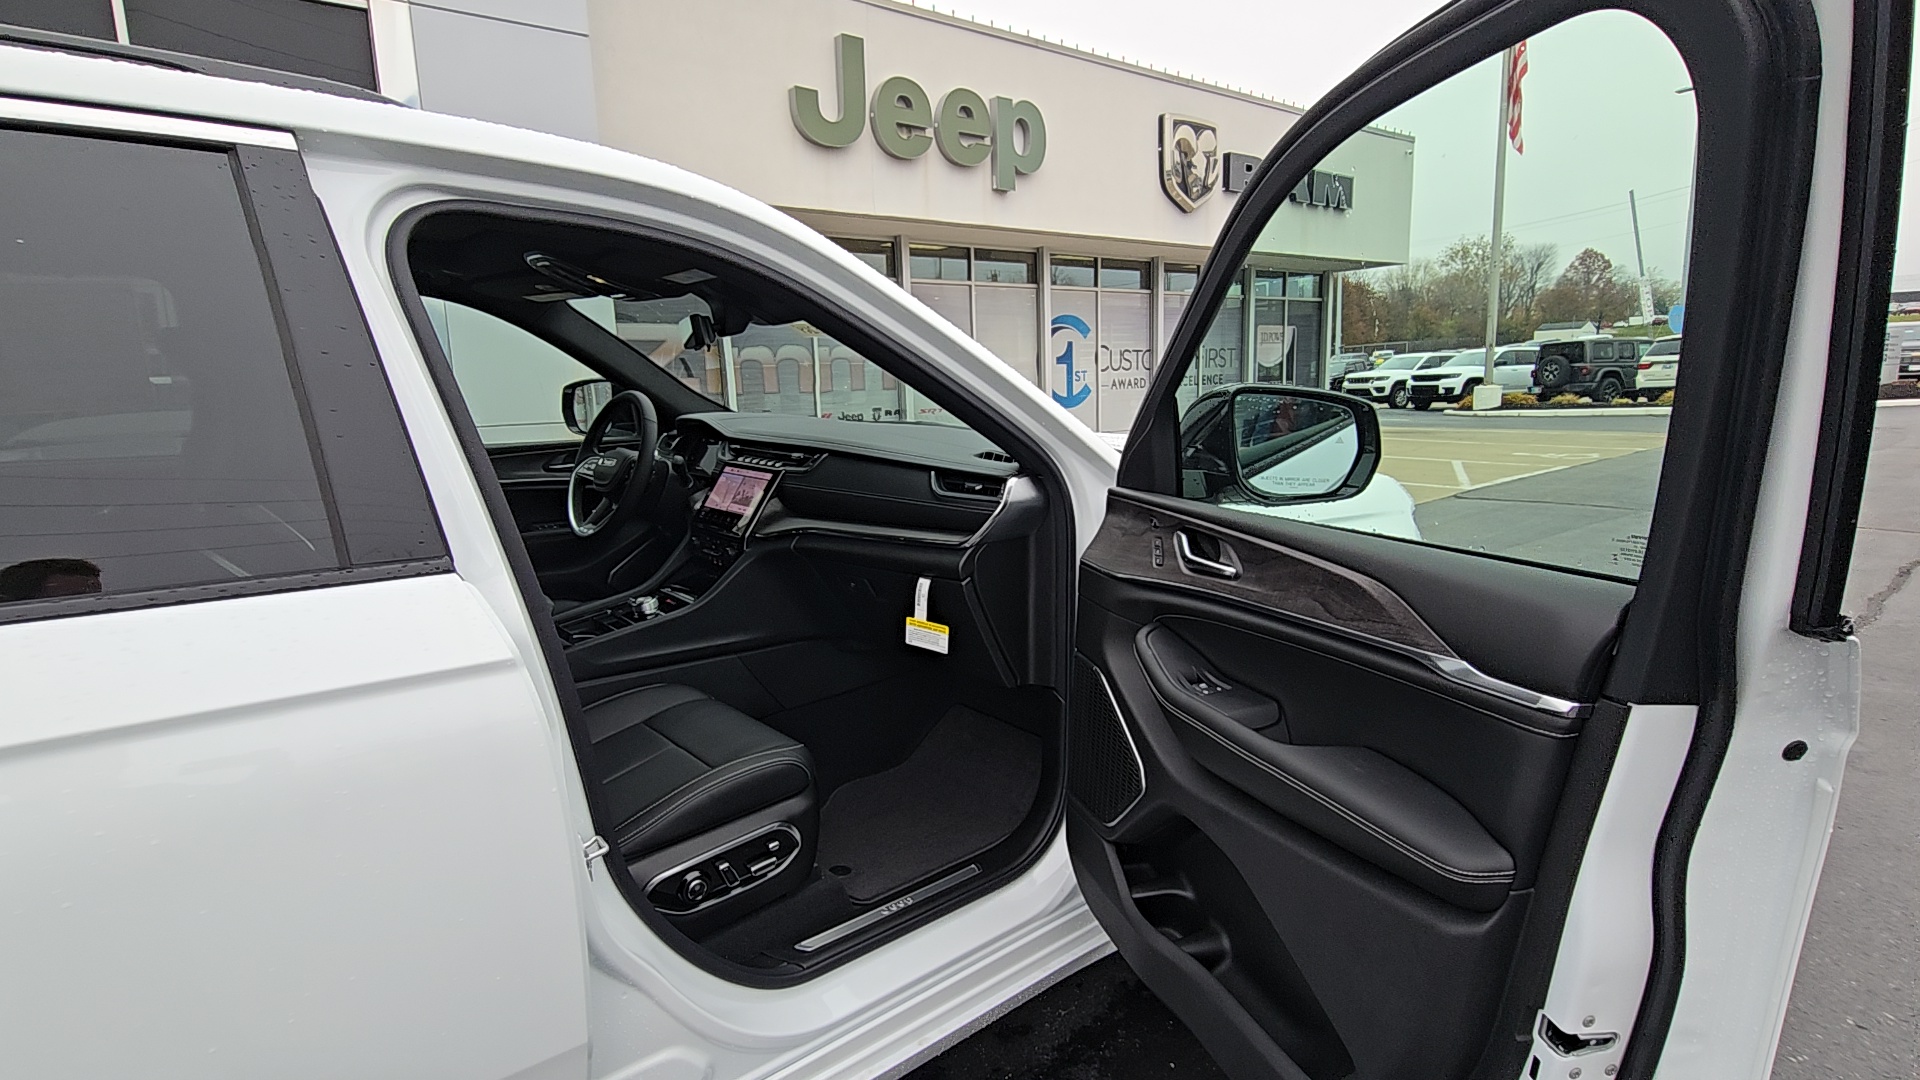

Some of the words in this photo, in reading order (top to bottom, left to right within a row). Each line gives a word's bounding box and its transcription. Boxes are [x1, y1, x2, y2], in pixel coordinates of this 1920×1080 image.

[789, 33, 1047, 192] Jeep
[1222, 151, 1355, 209] RM
[1111, 377, 1146, 390] AWARD
[1181, 374, 1224, 386] CELENCE
[837, 411, 864, 421] Jeep
